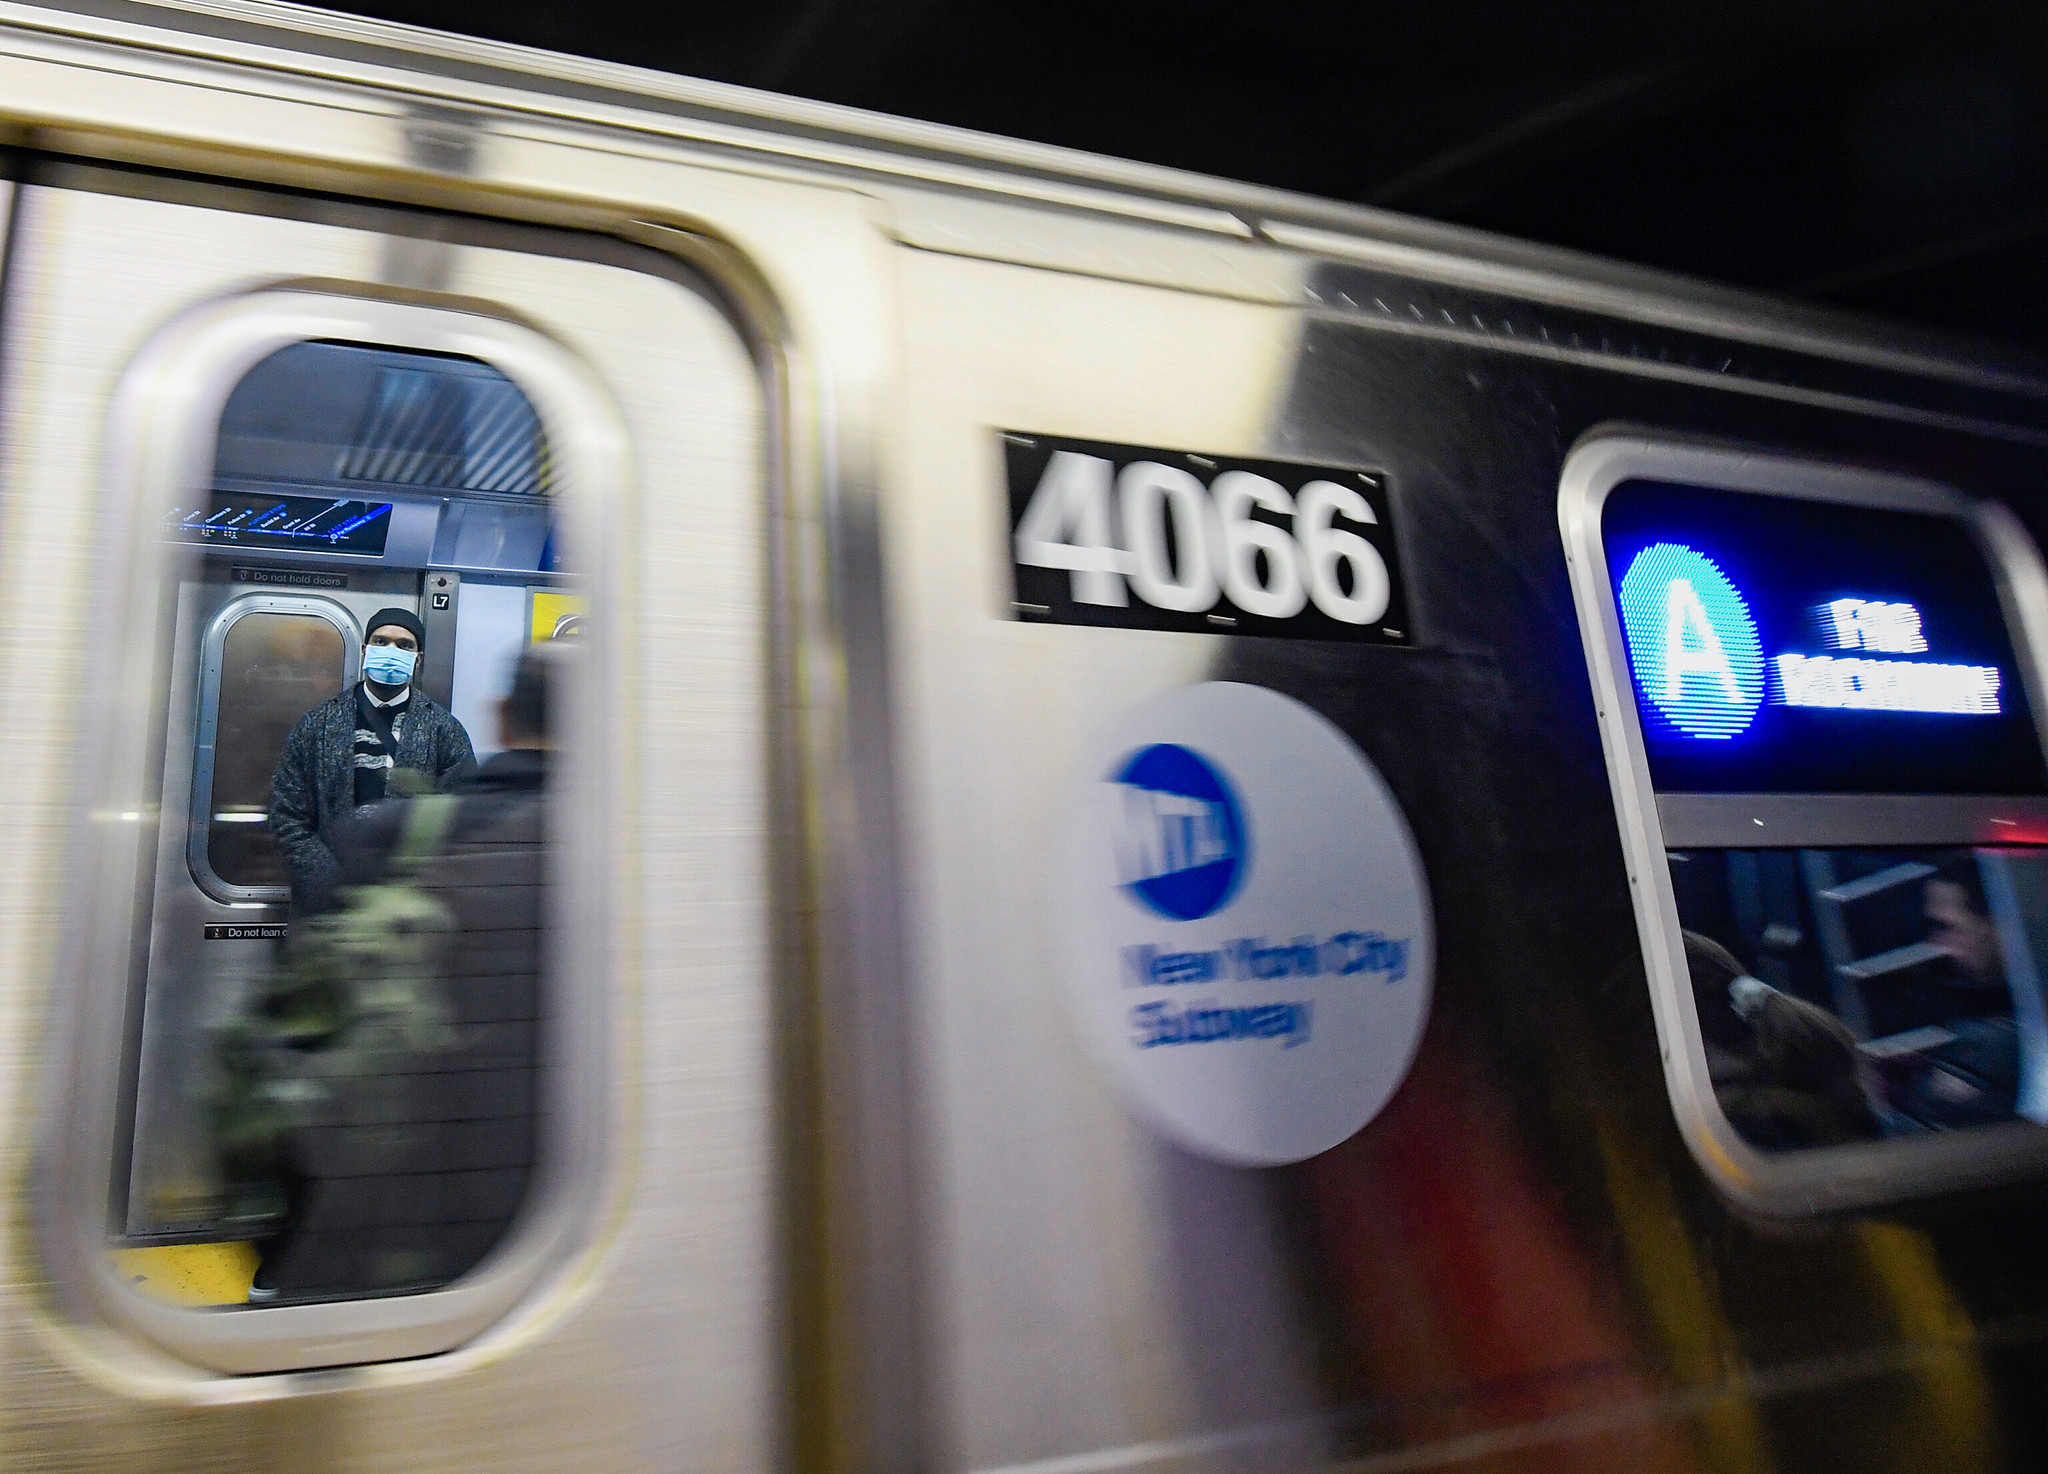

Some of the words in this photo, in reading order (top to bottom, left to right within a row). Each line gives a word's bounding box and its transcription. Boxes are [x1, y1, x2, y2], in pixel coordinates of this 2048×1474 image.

[1015, 449, 1390, 625] 4066
[254, 571, 268, 582] Do
[270, 573, 287, 583] not
[289, 573, 310, 584] hold
[313, 575, 341, 587] doors
[433, 595, 449, 608] L7
[1664, 577, 1748, 706] A
[228, 927, 243, 937] Do
[243, 928, 260, 937] not
[261, 927, 281, 937] lean
